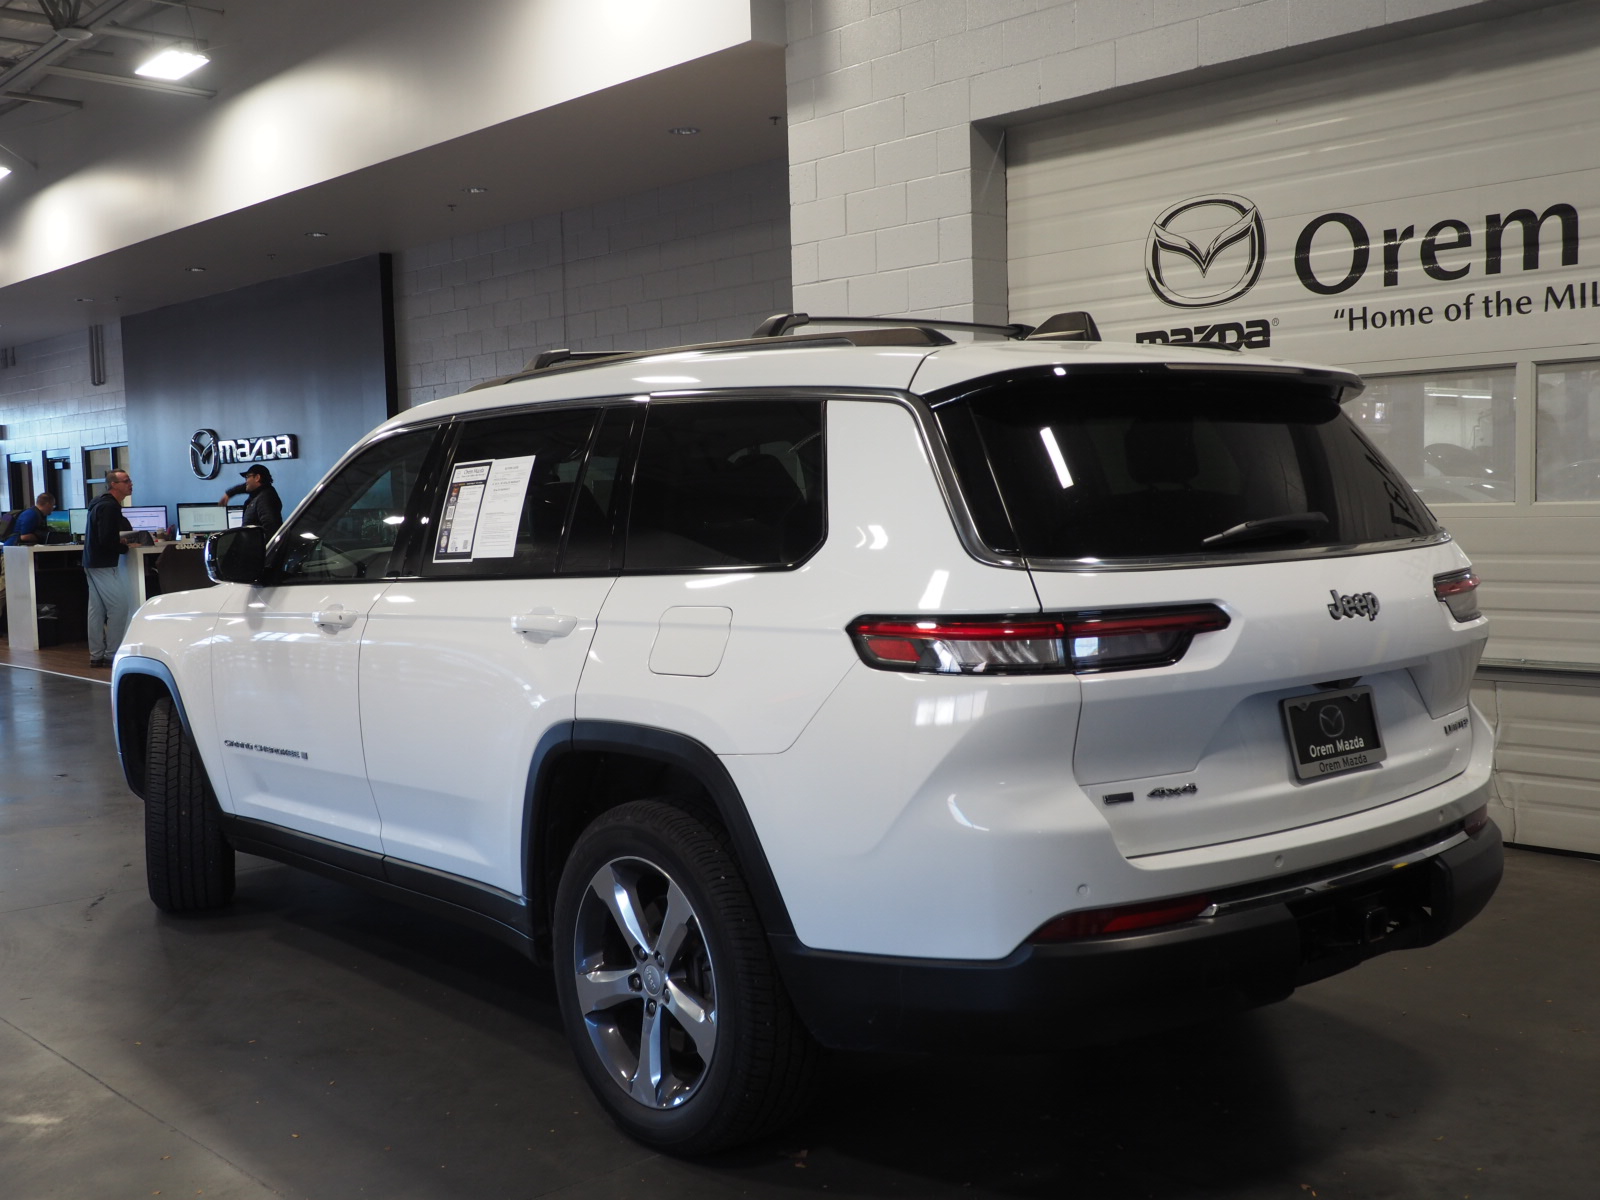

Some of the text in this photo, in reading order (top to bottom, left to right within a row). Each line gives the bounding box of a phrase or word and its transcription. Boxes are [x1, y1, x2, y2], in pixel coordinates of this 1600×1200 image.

[1294, 202, 1580, 296] Orem
[1444, 293, 1475, 322] of
[1482, 290, 1533, 318] the
[218, 435, 295, 464] mazda
[1327, 589, 1380, 621] Jeep
[1309, 736, 1365, 758] Orem Mazda
[1319, 754, 1368, 773] Orem Mazda
